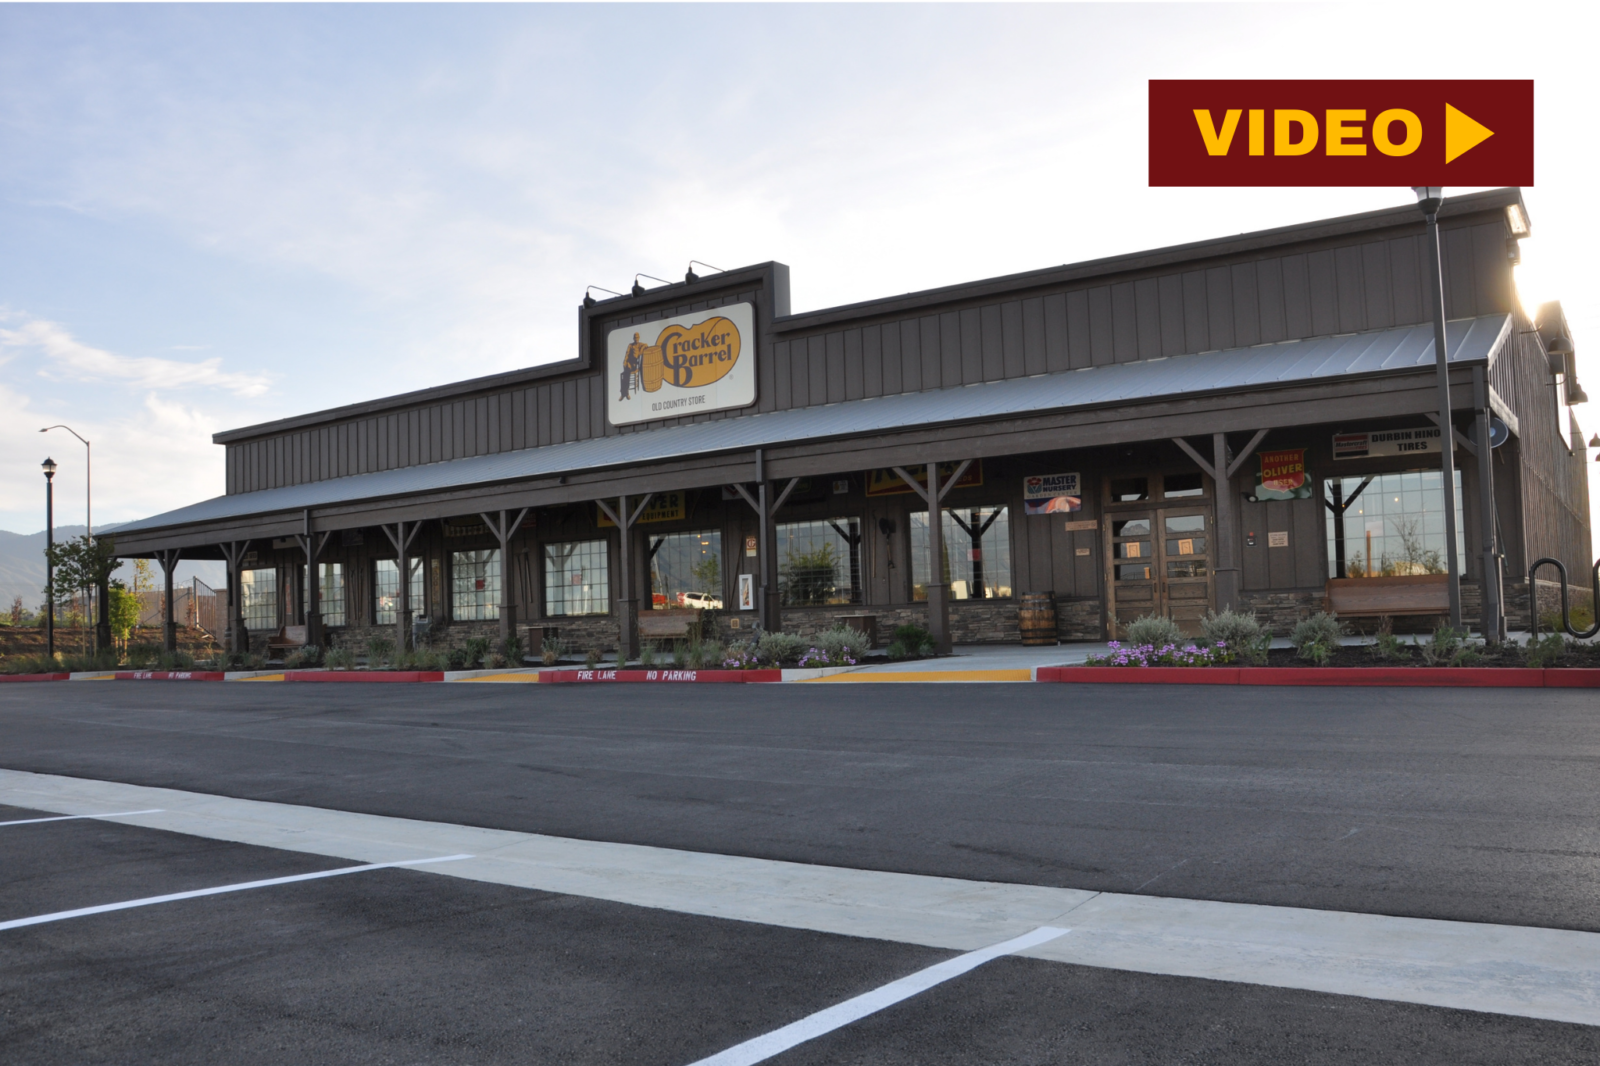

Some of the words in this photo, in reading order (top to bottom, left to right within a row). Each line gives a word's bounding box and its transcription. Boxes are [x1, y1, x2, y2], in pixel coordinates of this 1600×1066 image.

[661, 332, 730, 369] Cracker
[673, 344, 731, 387] Barrel
[652, 402, 662, 411] OLD
[663, 398, 687, 410] COUNTRY
[688, 395, 705, 405] STORE
[1372, 430, 1412, 442] DURBIN
[1414, 429, 1440, 439] HINO
[1397, 441, 1427, 451] TIRES
[1264, 454, 1299, 463] ANOTHER
[1263, 463, 1302, 478] OLIVER
[1043, 475, 1076, 487] MASTER
[1273, 478, 1294, 487] USER
[1043, 484, 1077, 492] NURSERY
[642, 509, 679, 521] EQUIPMENT
[577, 670, 594, 680] FIRE
[597, 670, 617, 680] LANE
[646, 671, 657, 680] NO
[662, 671, 697, 681] PARKING
